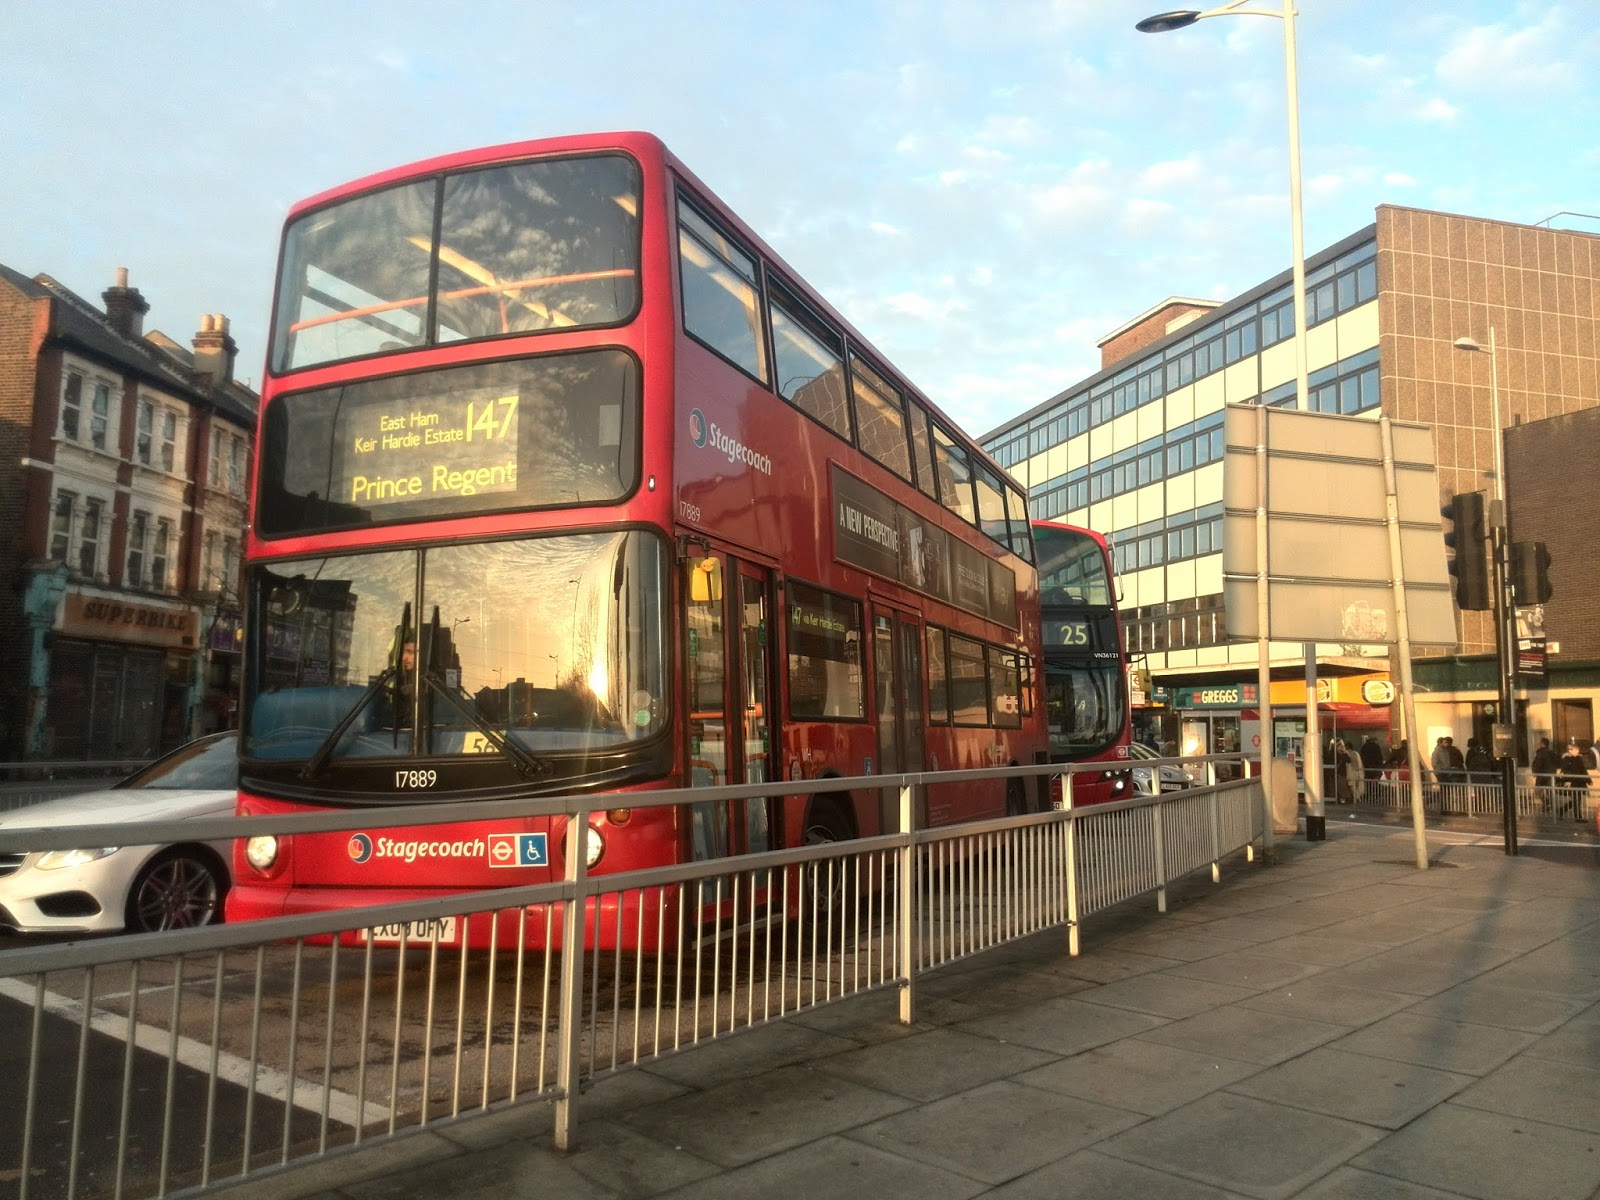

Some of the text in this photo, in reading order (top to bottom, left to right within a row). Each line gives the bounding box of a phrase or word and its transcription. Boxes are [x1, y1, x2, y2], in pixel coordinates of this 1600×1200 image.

[380, 411, 439, 432] East Ham
[466, 396, 519, 442] 147
[355, 428, 464, 453] Keir Hardie Estate
[709, 422, 772, 476] Stagecoach
[352, 460, 518, 502] Prince Regent
[679, 500, 701, 523] 17889
[839, 502, 899, 552] A NEW PERSPECTIVE
[83, 601, 186, 631] SUPERBIKE
[1061, 625, 1088, 646] 25
[1201, 689, 1238, 704] GREGGS
[395, 769, 437, 788] 17889
[376, 837, 485, 863] Stagecoach
